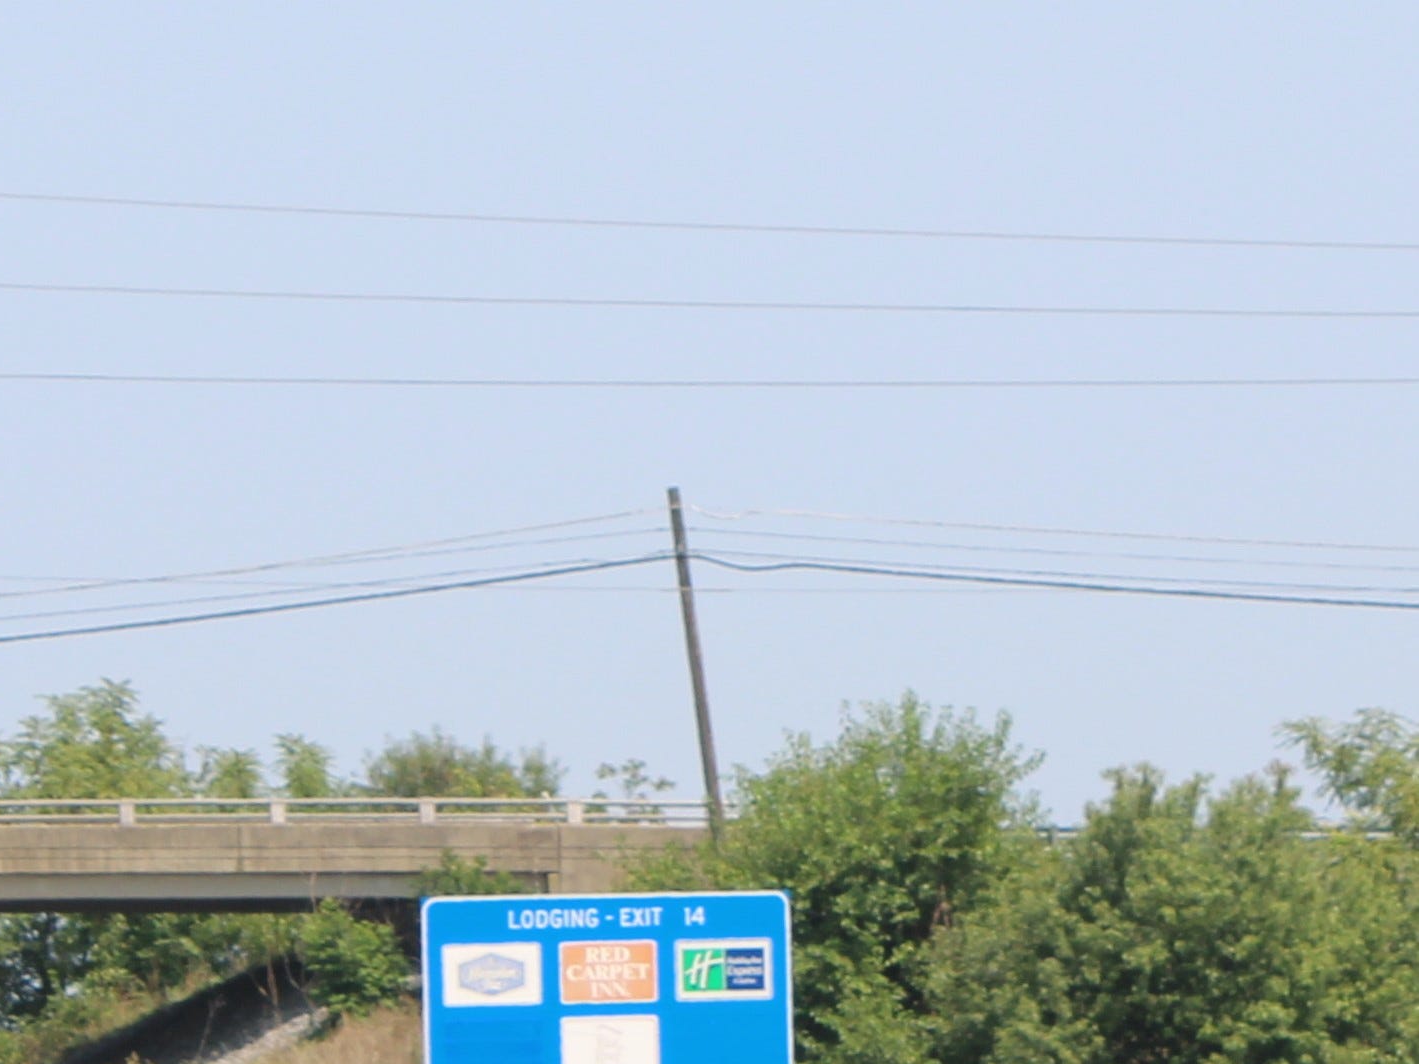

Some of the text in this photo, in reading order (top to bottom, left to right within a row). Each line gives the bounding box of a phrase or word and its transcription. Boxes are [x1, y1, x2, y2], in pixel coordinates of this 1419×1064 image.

[507, 908, 600, 929] LODGING
[619, 907, 663, 928] EXIT
[683, 906, 705, 926] 14
[585, 946, 631, 963] RED
[566, 963, 650, 981] CARPET
[590, 980, 632, 998] INN
